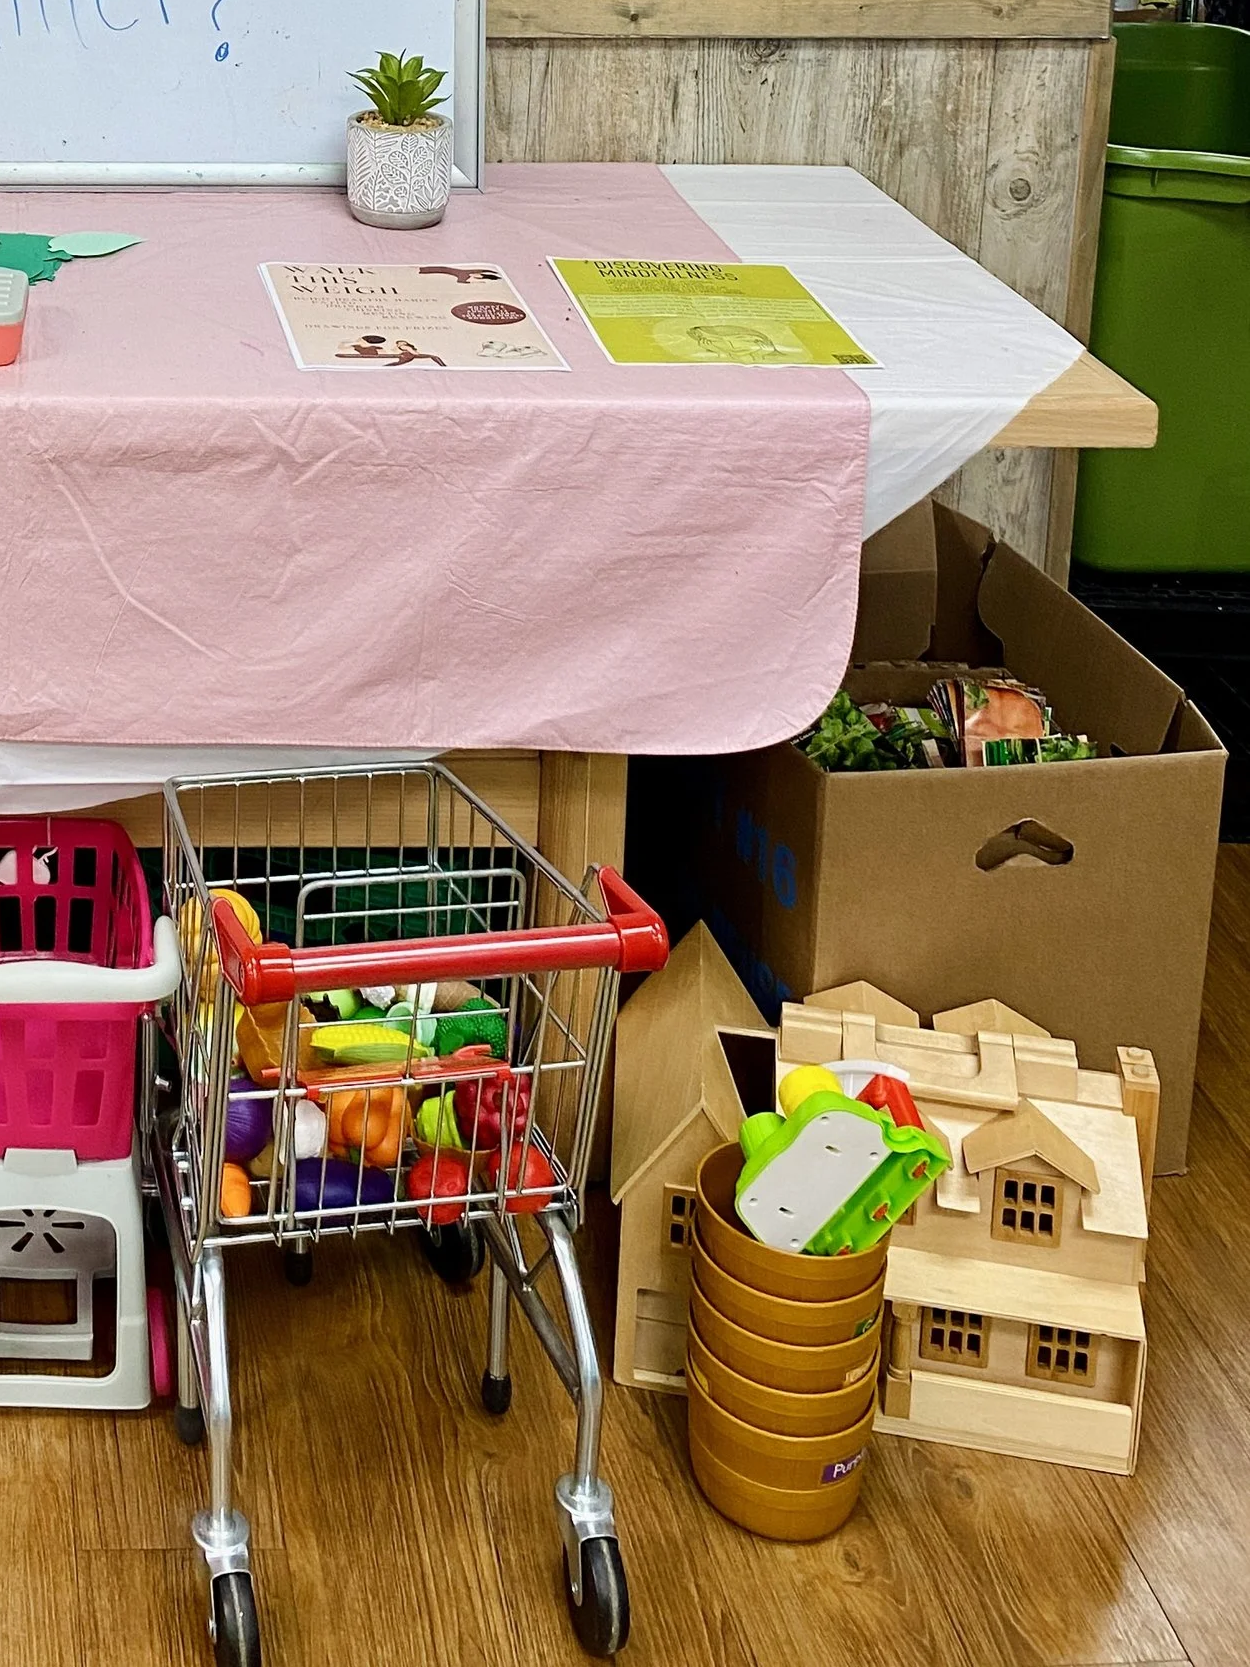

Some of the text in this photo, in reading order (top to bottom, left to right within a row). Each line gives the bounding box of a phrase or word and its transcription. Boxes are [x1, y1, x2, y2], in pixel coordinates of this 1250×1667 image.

[282, 265, 379, 276] WALK
[593, 260, 723, 273] DISCOVERING
[287, 274, 358, 285] THIS
[598, 269, 739, 282] MINDFULNESS
[290, 284, 400, 296] WEIGH
